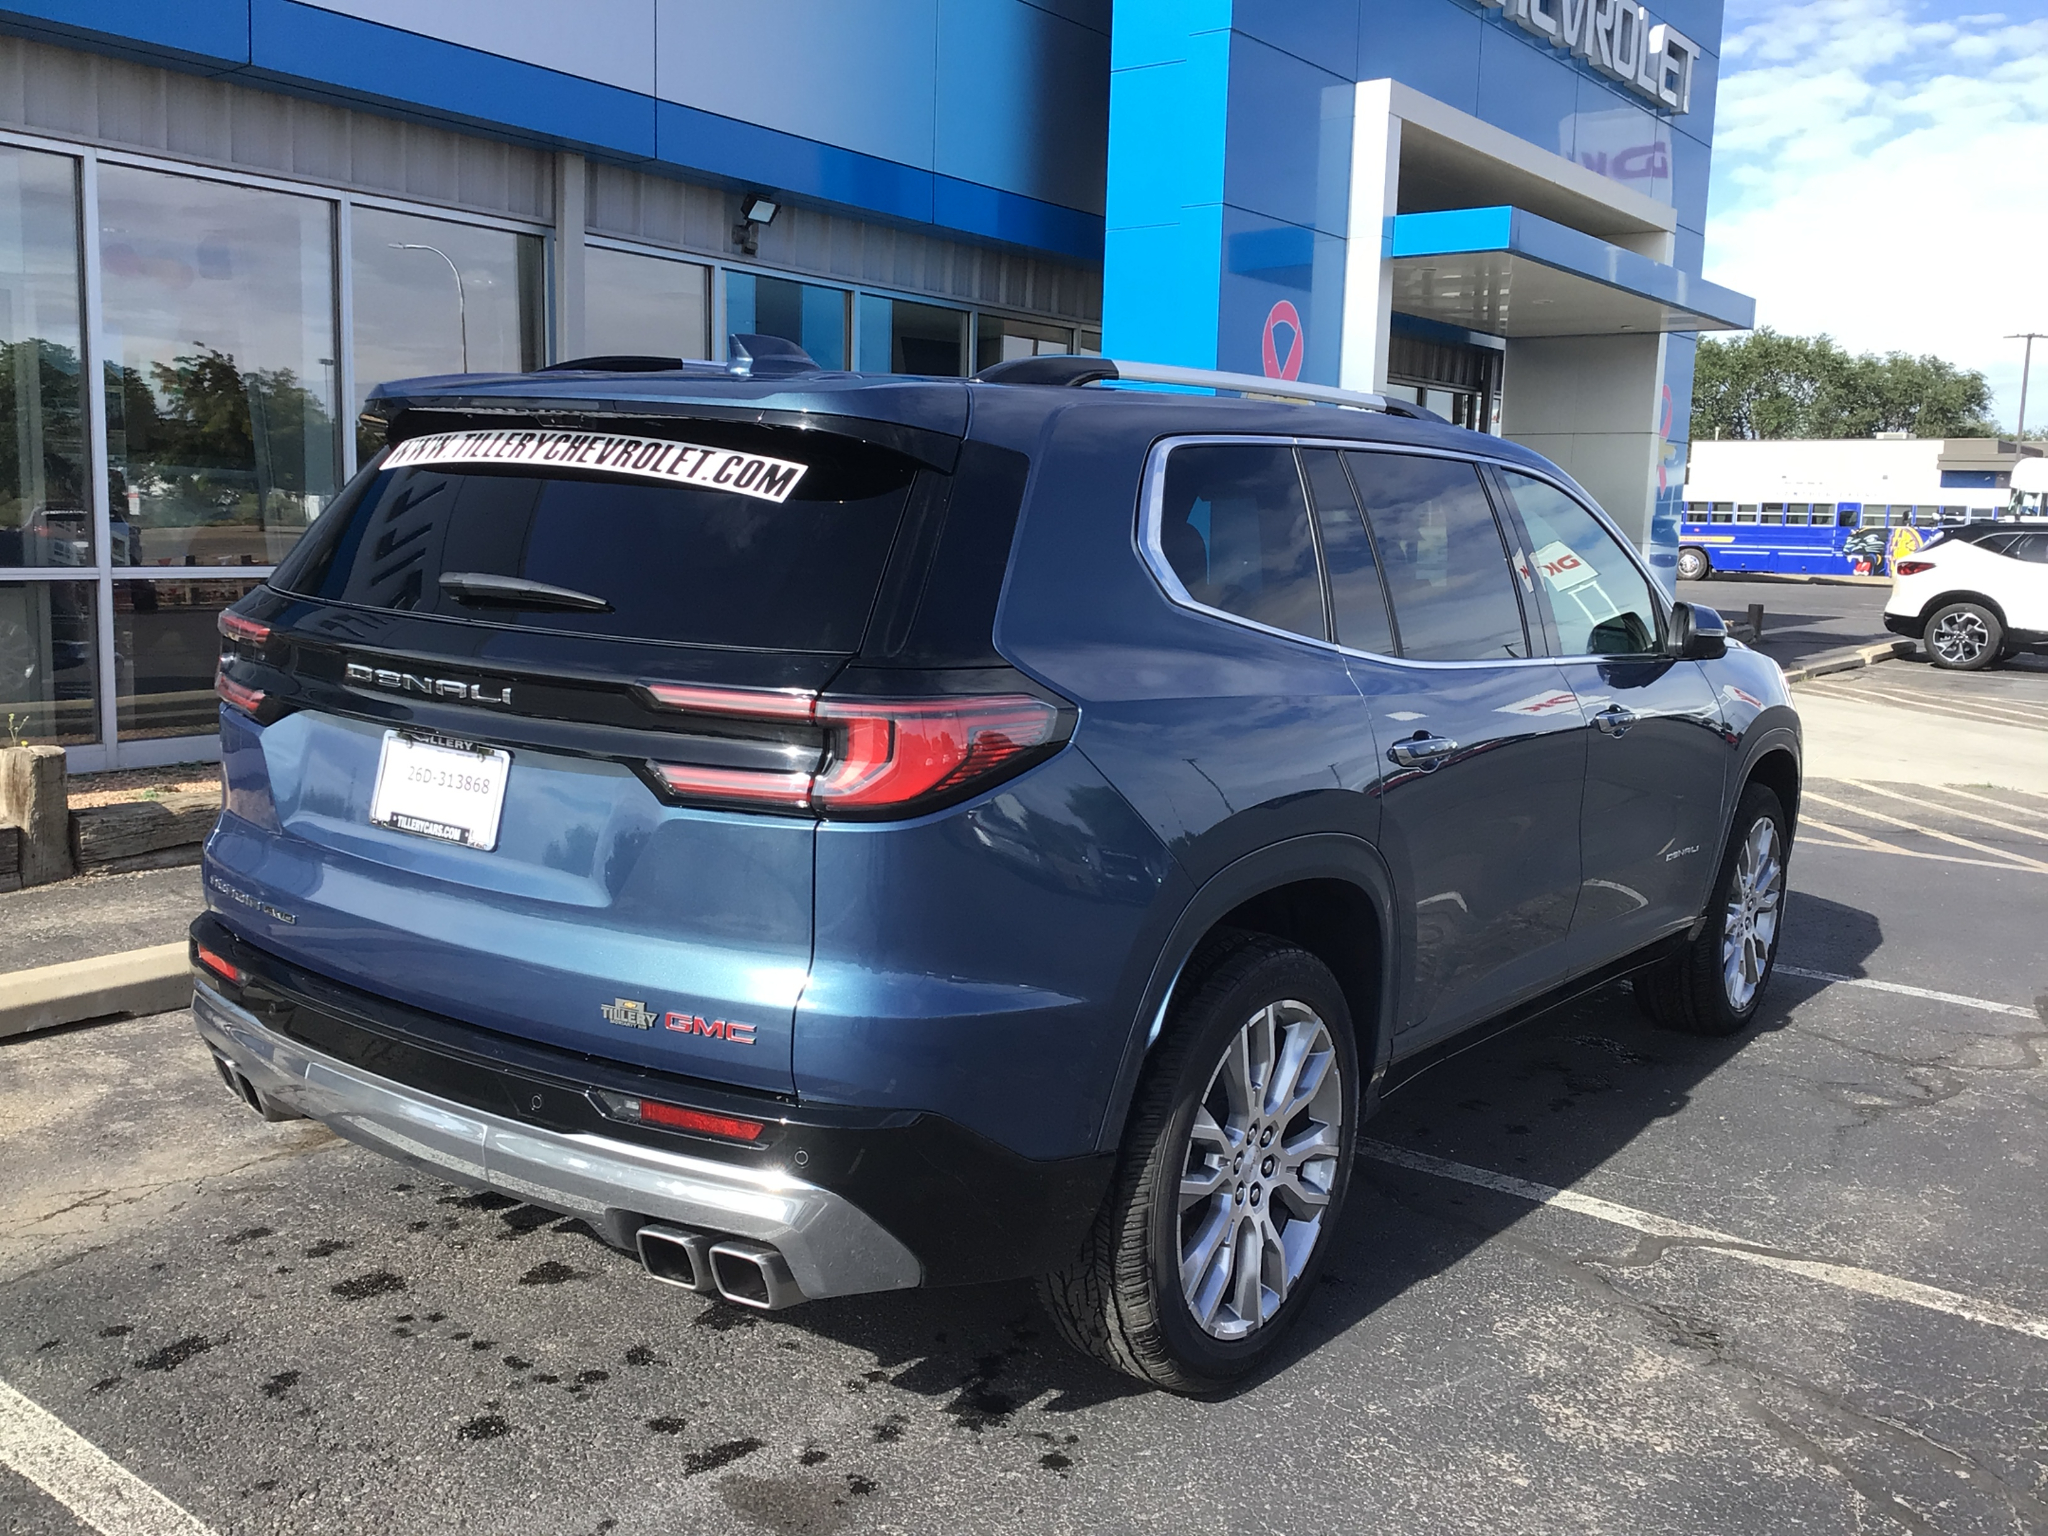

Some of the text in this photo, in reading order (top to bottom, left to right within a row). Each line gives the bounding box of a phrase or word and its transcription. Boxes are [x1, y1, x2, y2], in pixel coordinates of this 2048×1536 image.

[1476, 0, 1700, 115] VROLET
[391, 431, 797, 498] WWW.TILLERYCHEVROLET.COM
[346, 663, 512, 705] DENALI
[407, 765, 491, 795] 26D-313868
[396, 815, 462, 841] TILLERYCARS.COM
[600, 1006, 657, 1028] TILLERY
[665, 1011, 757, 1045] GMC
